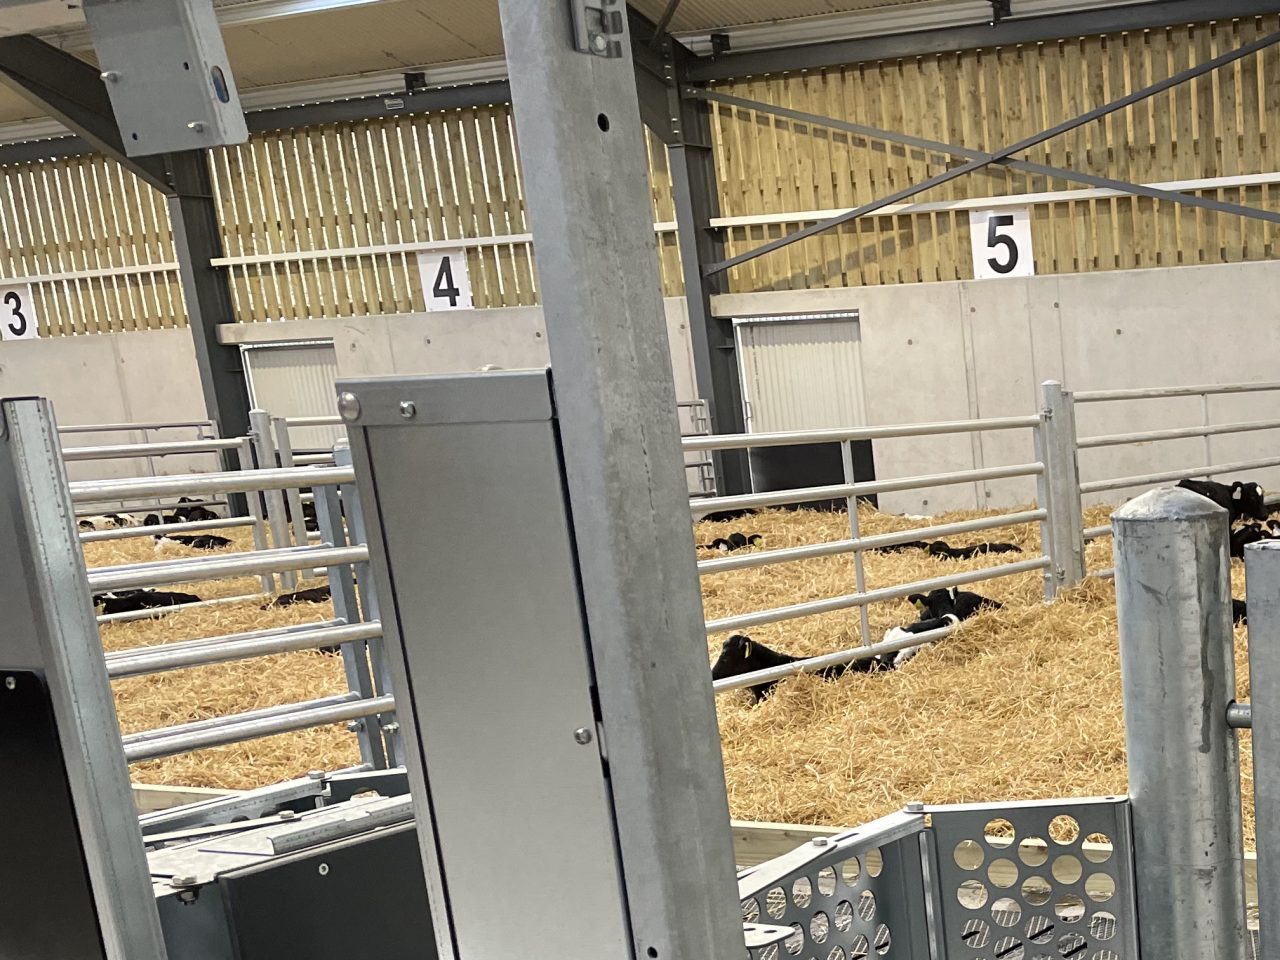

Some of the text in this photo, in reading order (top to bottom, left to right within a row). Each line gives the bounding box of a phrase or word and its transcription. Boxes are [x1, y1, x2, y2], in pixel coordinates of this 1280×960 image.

[987, 215, 1019, 273] 5
[432, 256, 460, 306] 4
[4, 291, 27, 336] 3
